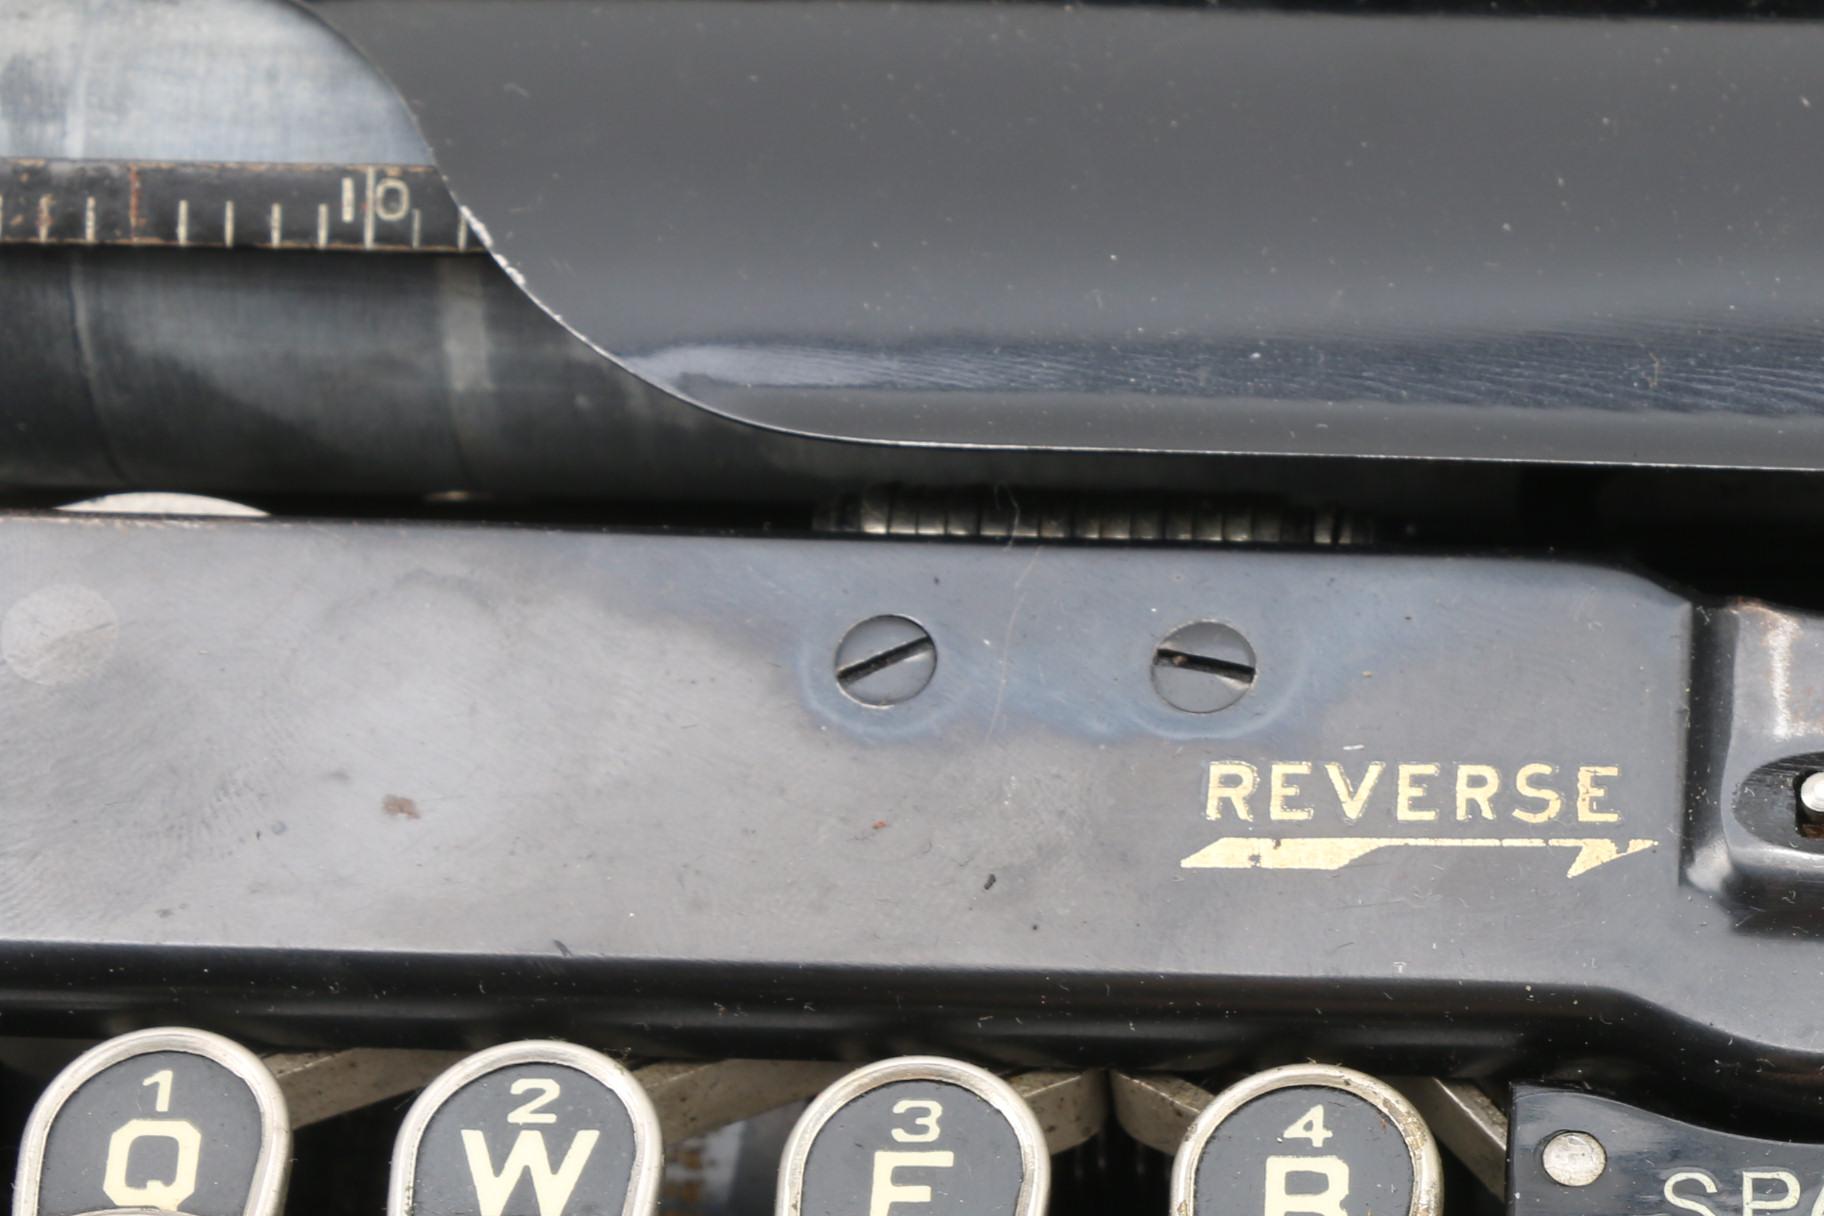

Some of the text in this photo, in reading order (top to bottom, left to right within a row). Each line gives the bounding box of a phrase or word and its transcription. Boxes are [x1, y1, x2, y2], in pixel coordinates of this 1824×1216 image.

[341, 176, 410, 223] 10
[1206, 760, 1621, 823] REVERSE
[142, 1069, 174, 1112] 1
[507, 1078, 561, 1125] 2
[891, 1099, 943, 1143] 3
[1283, 1104, 1333, 1148] 4
[102, 1118, 204, 1210] Q
